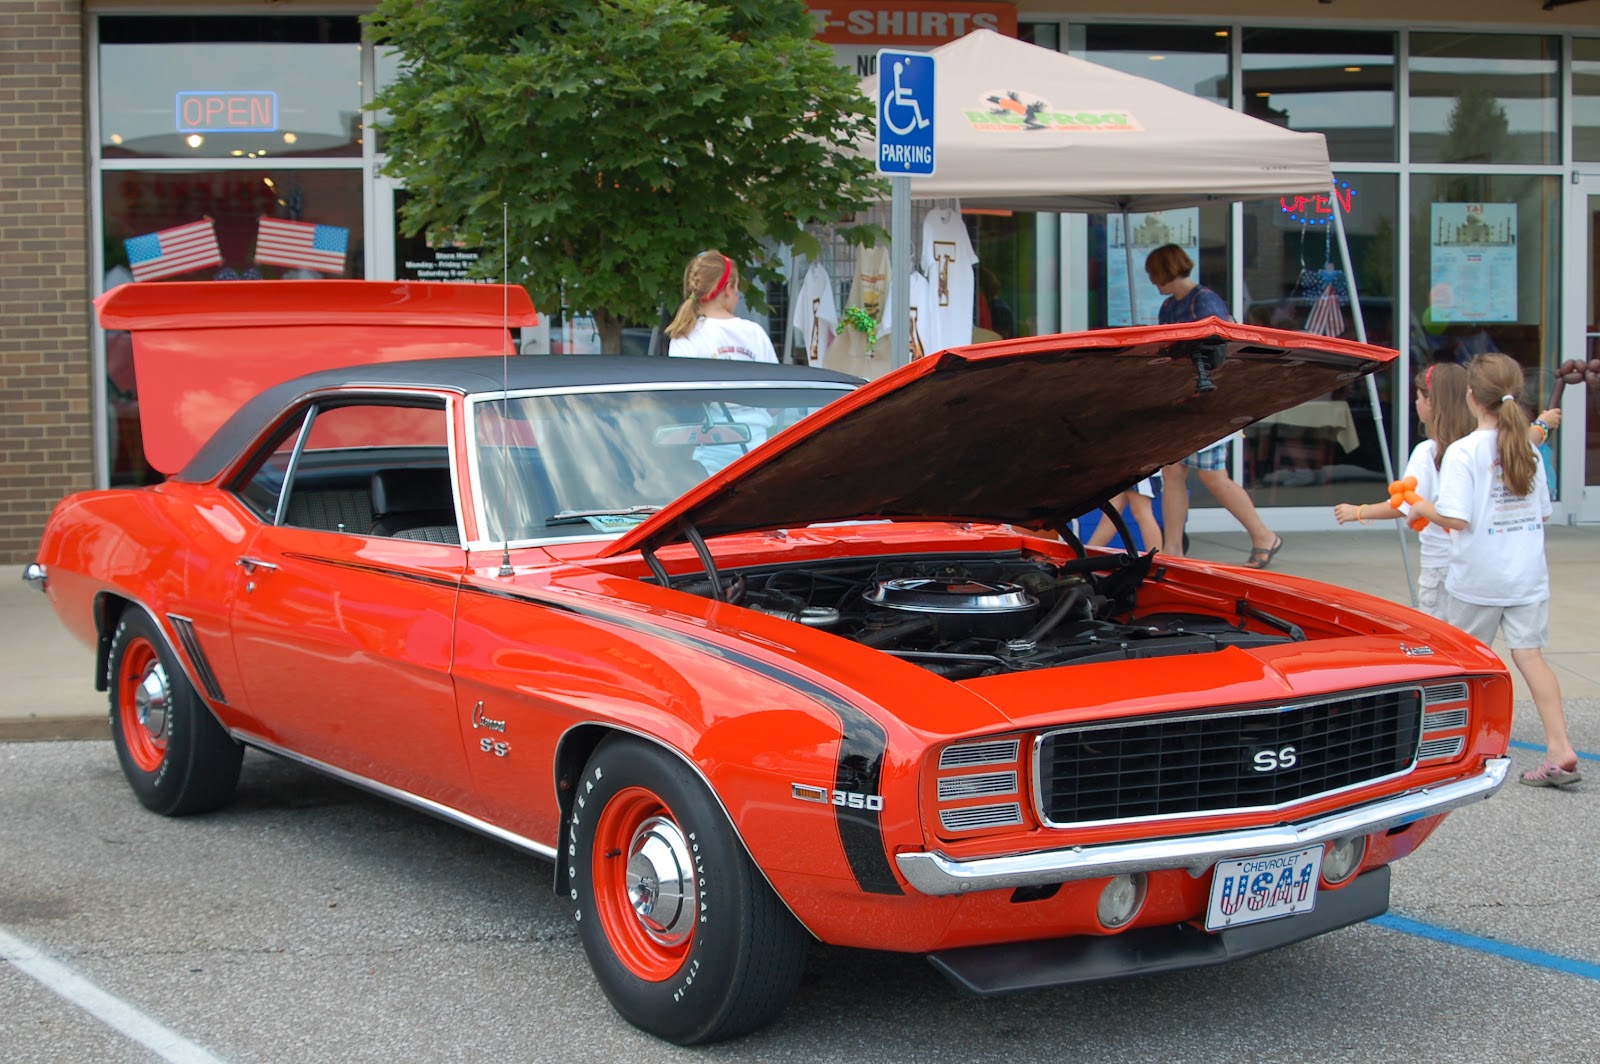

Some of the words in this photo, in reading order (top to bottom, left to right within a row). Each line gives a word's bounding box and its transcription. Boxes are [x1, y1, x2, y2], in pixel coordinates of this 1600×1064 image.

[808, 9, 998, 36] T-SHIRTS
[183, 97, 271, 126] OPEN
[881, 143, 932, 164] PARKING
[405, 261, 434, 270] Monday
[438, 261, 461, 270] Friday
[435, 252, 455, 260] Store
[456, 252, 478, 260] Hours
[480, 737, 510, 757] SS
[1253, 746, 1296, 772] SS
[831, 789, 884, 811] 350
[1243, 855, 1300, 874] CHEVROLET
[688, 831, 708, 923] POLYGLAS
[1220, 863, 1313, 916] USA-1
